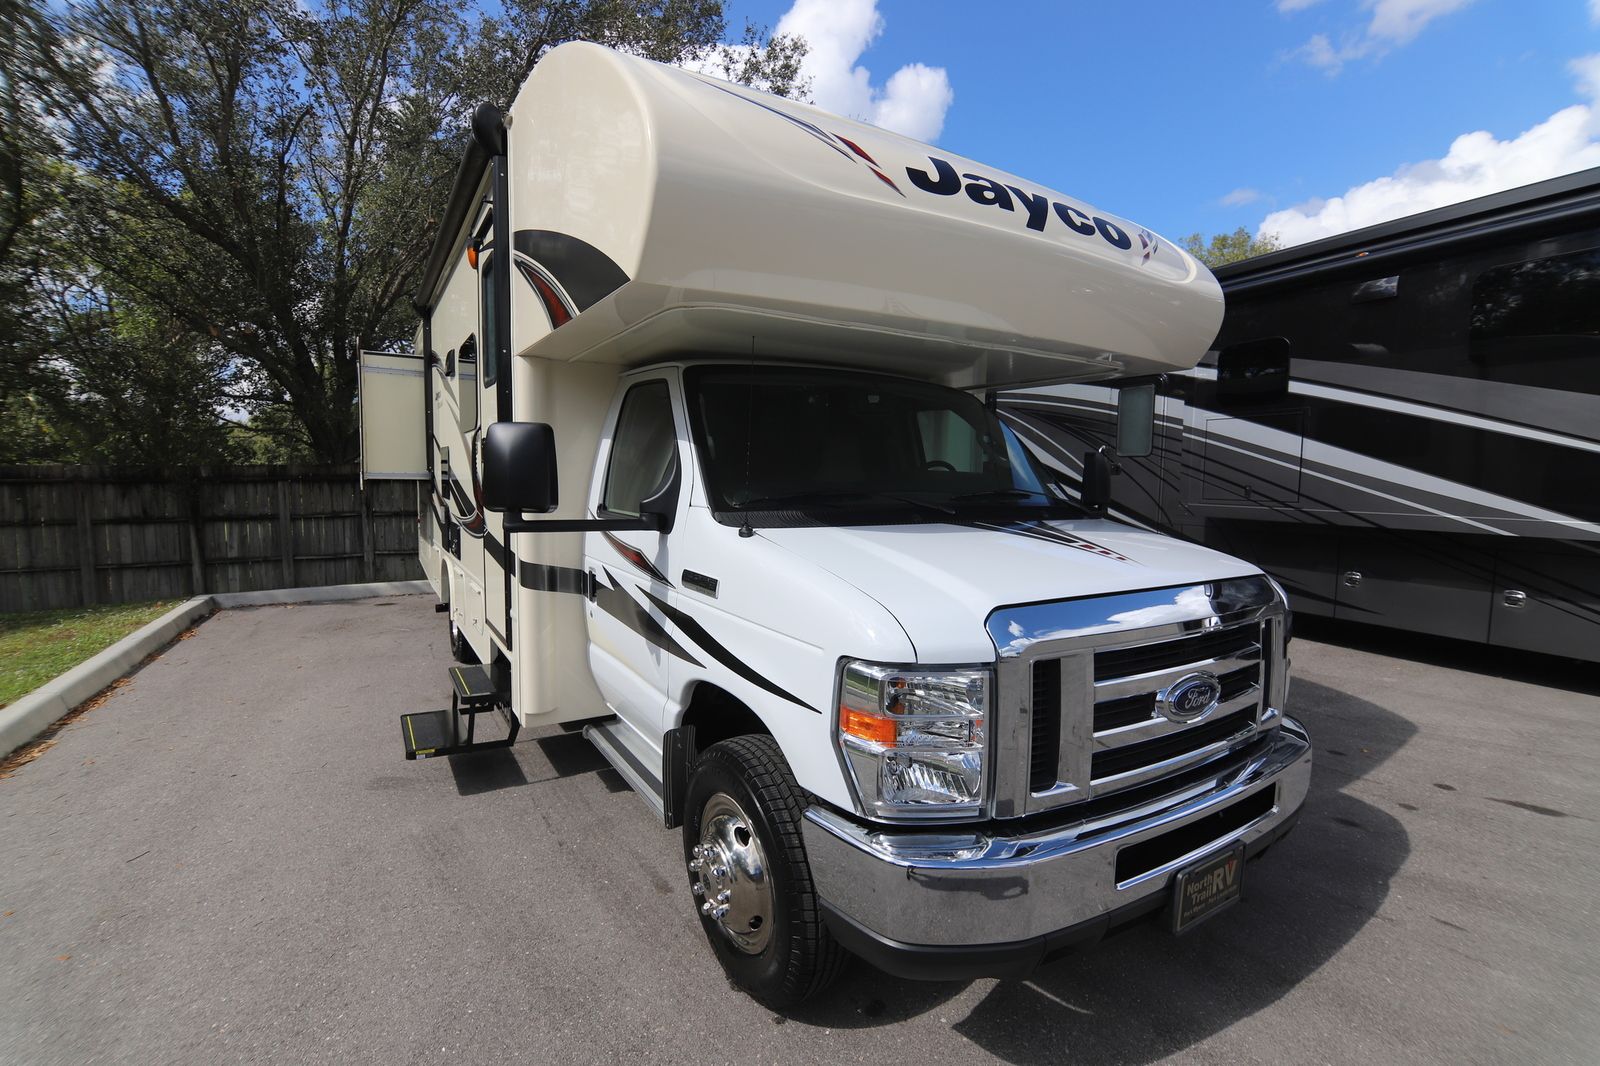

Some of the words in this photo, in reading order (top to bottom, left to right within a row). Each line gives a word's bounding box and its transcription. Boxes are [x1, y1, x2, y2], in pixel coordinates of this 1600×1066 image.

[905, 156, 1132, 250] Jayco
[1184, 687, 1211, 709] Ford
[1187, 873, 1213, 896] North
[1212, 859, 1237, 894] RV
[1191, 885, 1212, 905] Trail
